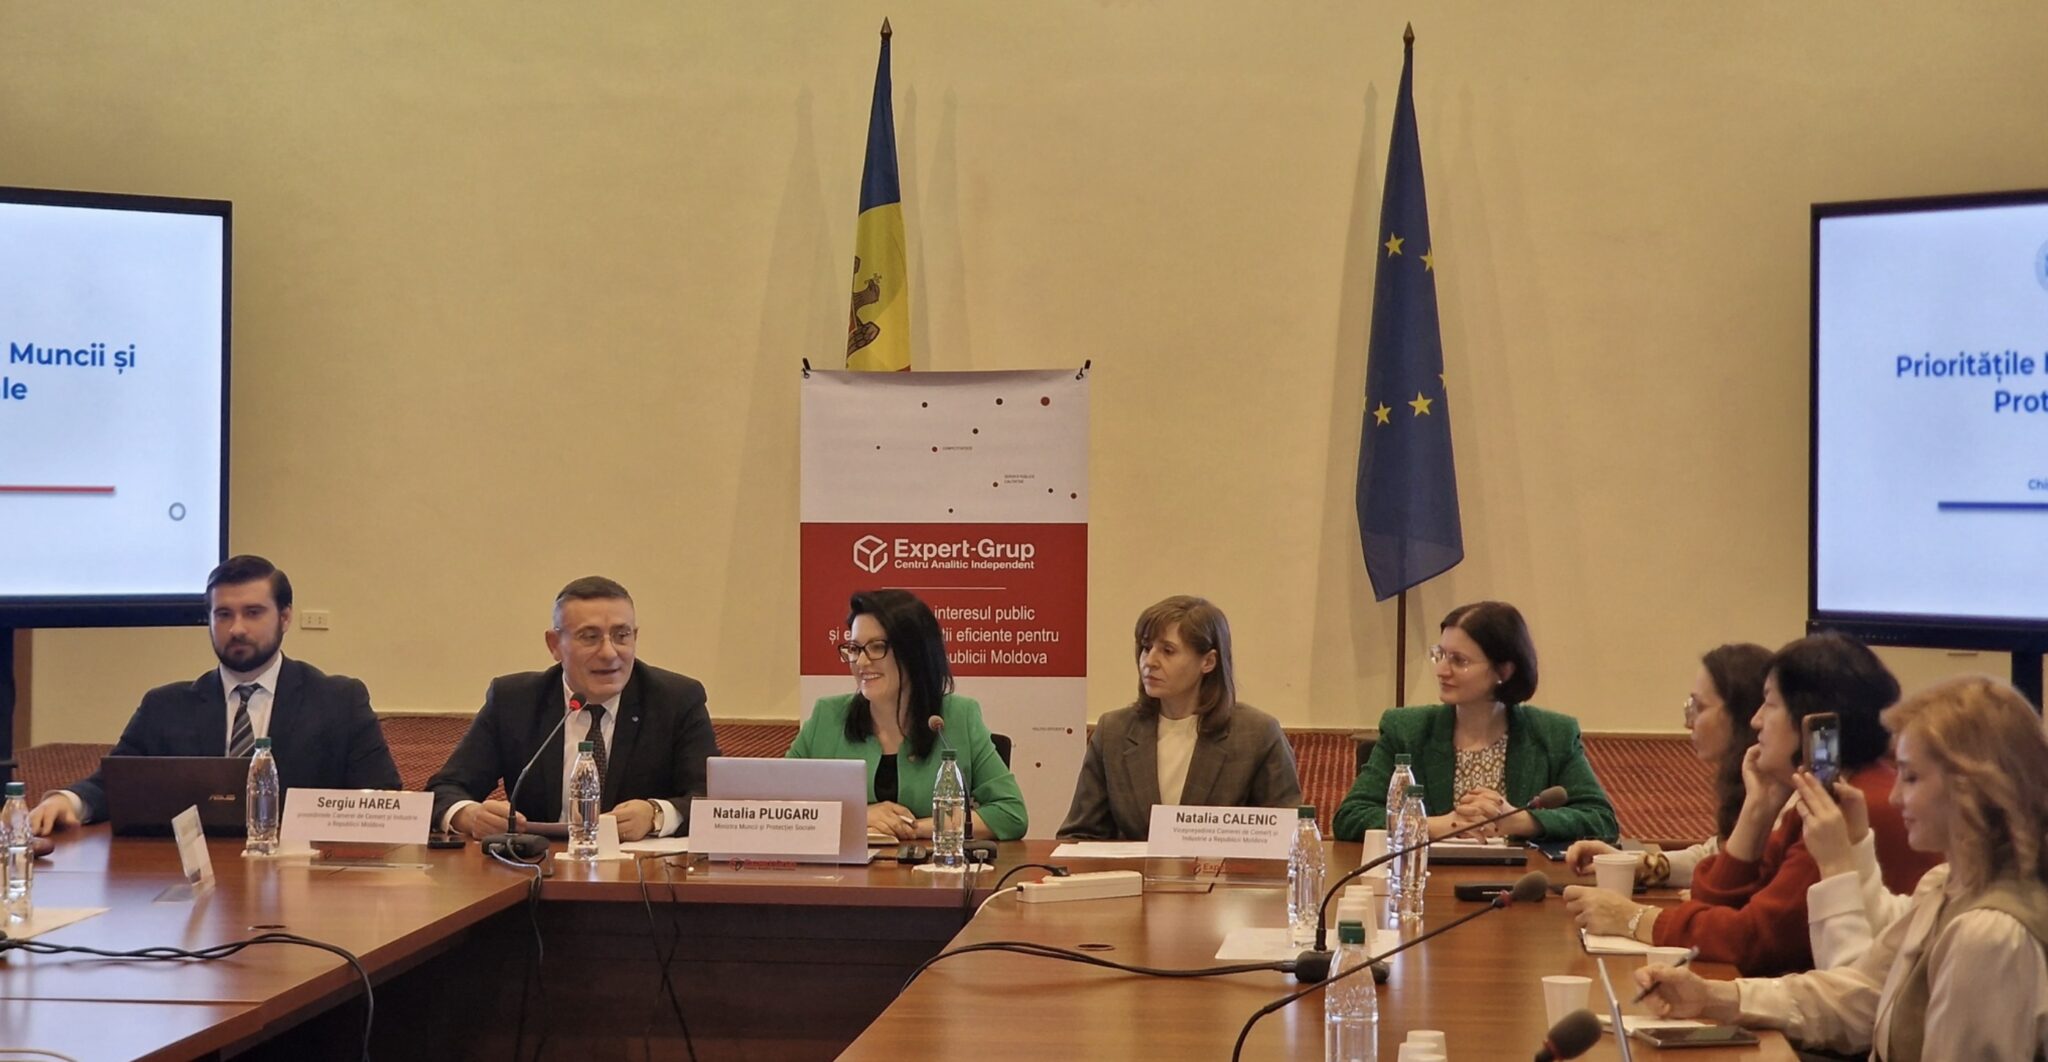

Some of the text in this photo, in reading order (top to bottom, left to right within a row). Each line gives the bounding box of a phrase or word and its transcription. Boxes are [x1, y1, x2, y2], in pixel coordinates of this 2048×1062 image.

[10, 342, 135, 375] Muncii și
[1896, 350, 2035, 383] Prioritățile
[2, 376, 28, 400] le
[1994, 390, 2048, 413] Prot
[894, 538, 1035, 561] Expert-Grup
[894, 559, 1035, 571] Centru Analitic Independent
[934, 604, 1035, 623] interesul public
[956, 627, 1012, 642] eficiente
[1016, 629, 1059, 645] pentru
[948, 649, 1048, 664] ublicii Moldova
[317, 796, 401, 811] Sergiu HAREA
[713, 806, 819, 820] Natalia PLUGARU
[1176, 811, 1278, 826] Natalia CALENIC
